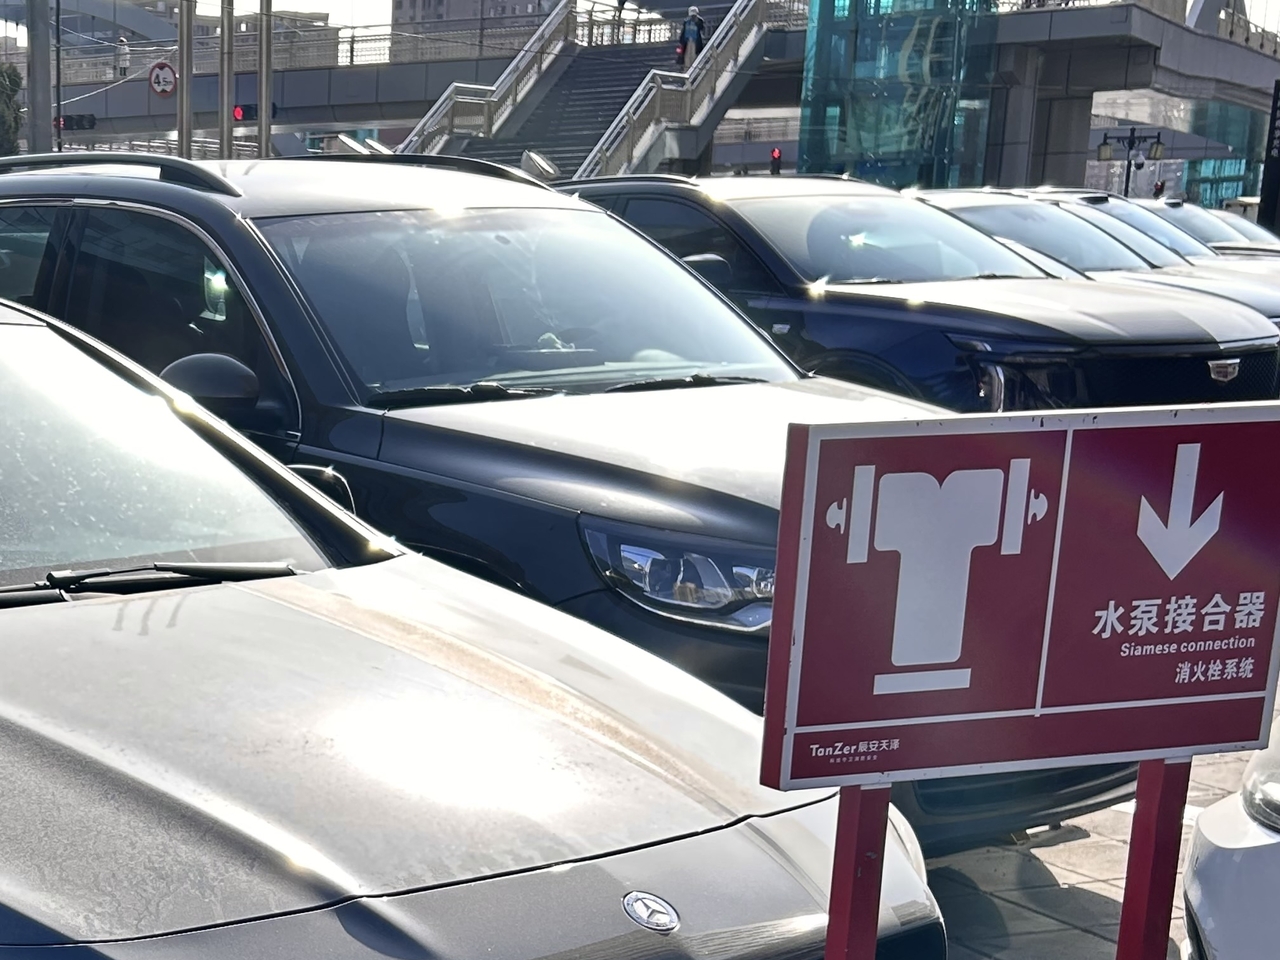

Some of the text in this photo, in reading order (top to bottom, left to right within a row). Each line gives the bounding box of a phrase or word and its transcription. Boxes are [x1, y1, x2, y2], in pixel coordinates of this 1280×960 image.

[1092, 591, 1266, 639] 水泵接合器
[1120, 635, 1255, 657] Siamese connection
[1174, 656, 1255, 684] 消火栓系统
